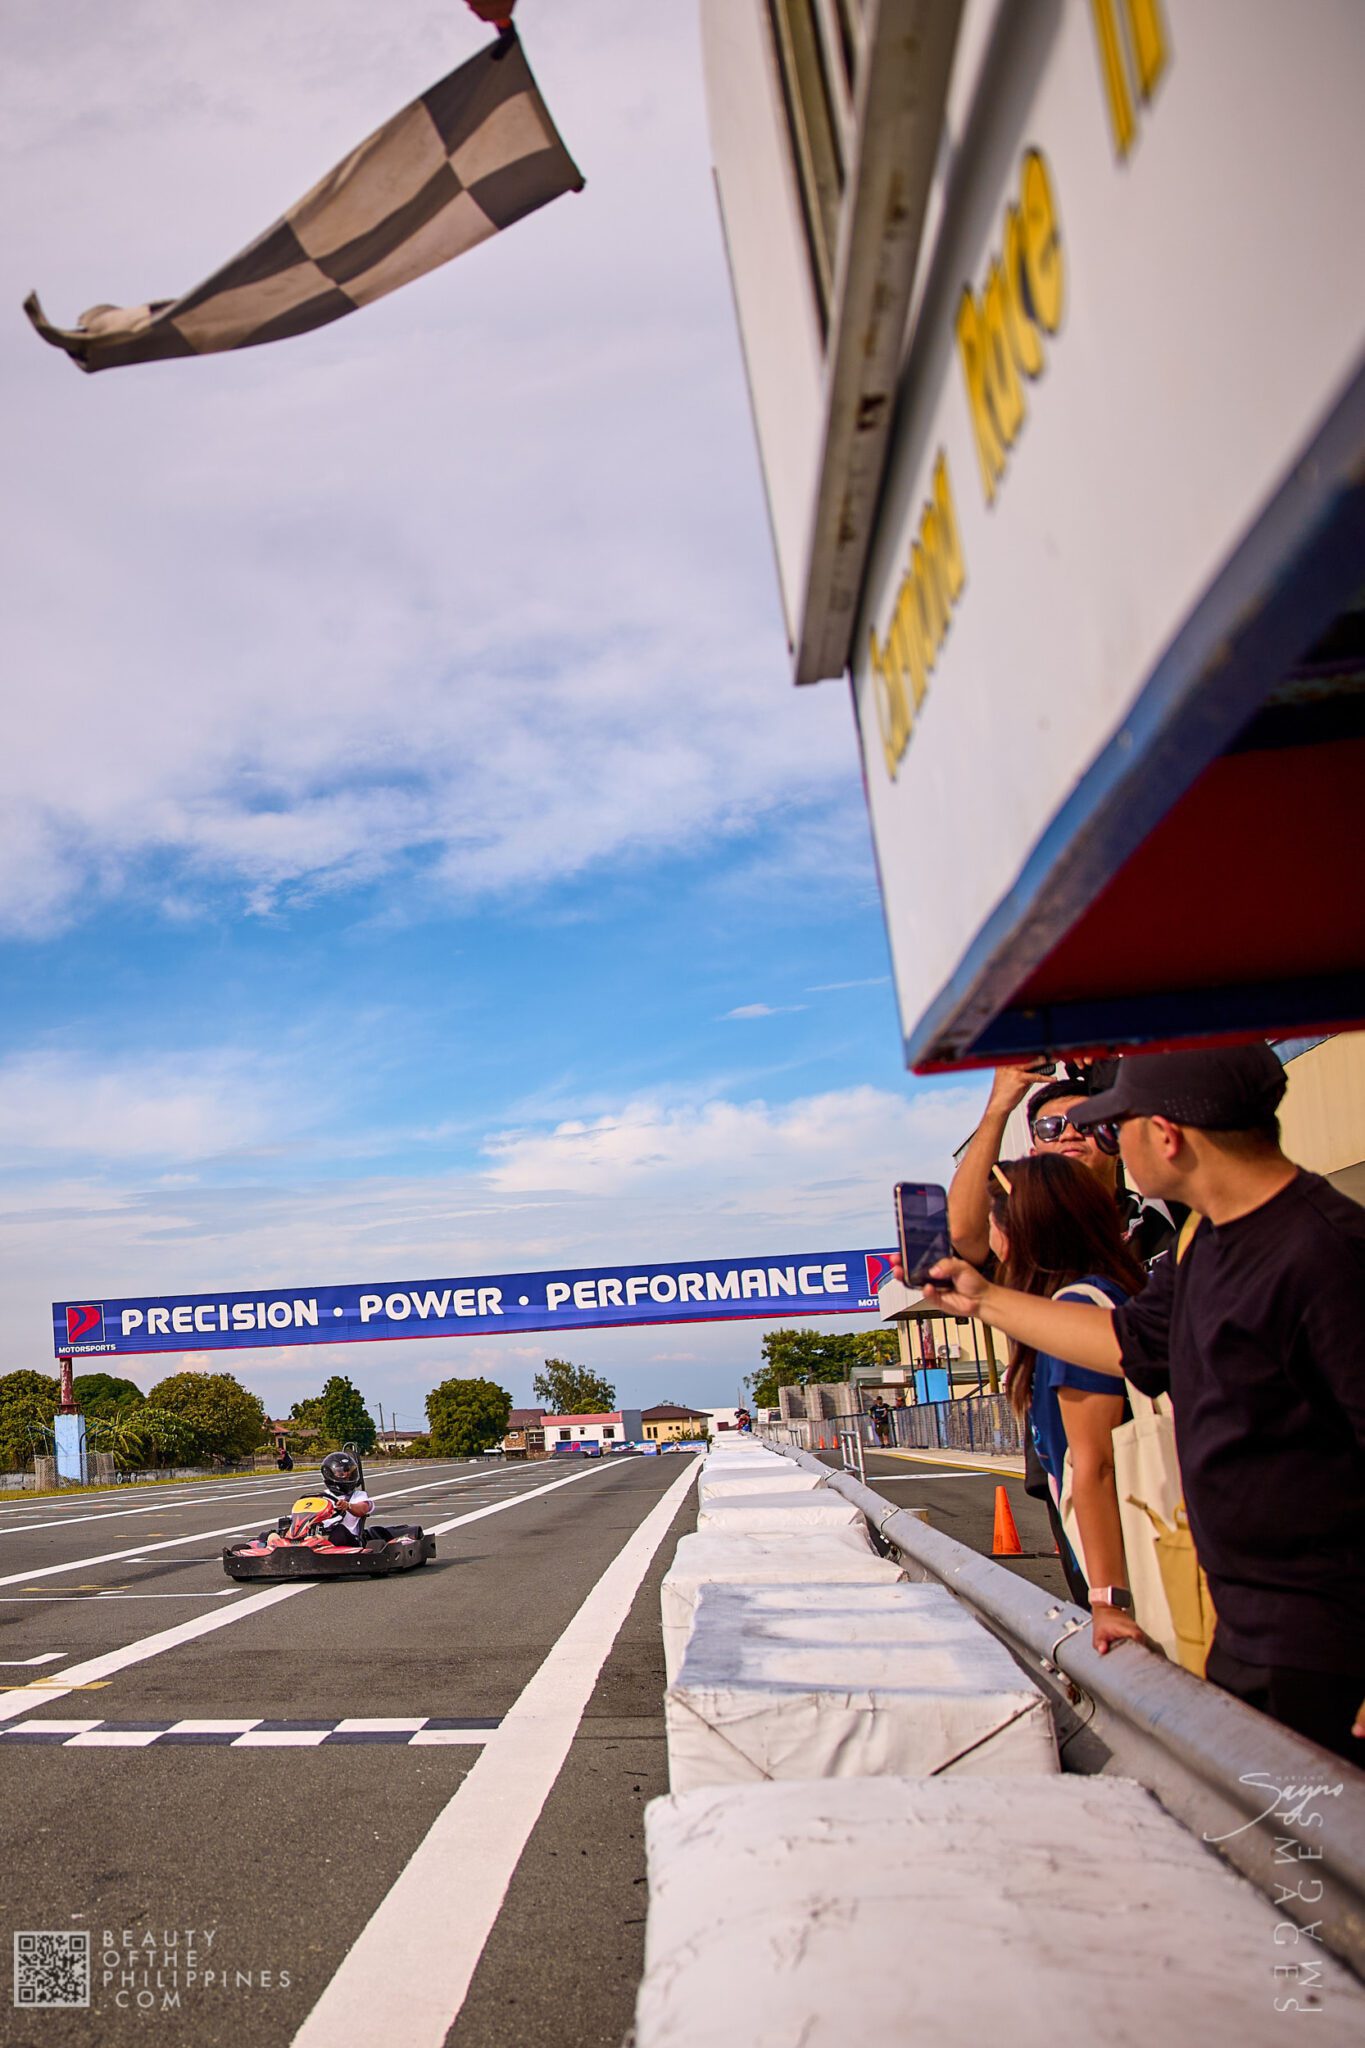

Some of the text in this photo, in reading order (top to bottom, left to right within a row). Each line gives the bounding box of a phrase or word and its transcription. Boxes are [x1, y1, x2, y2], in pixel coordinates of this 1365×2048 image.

[121, 1263, 849, 1336] PRECISION POWER PERFORMANCE
[58, 1343, 117, 1354] MOTORSPORTS
[304, 1501, 313, 1510] 2
